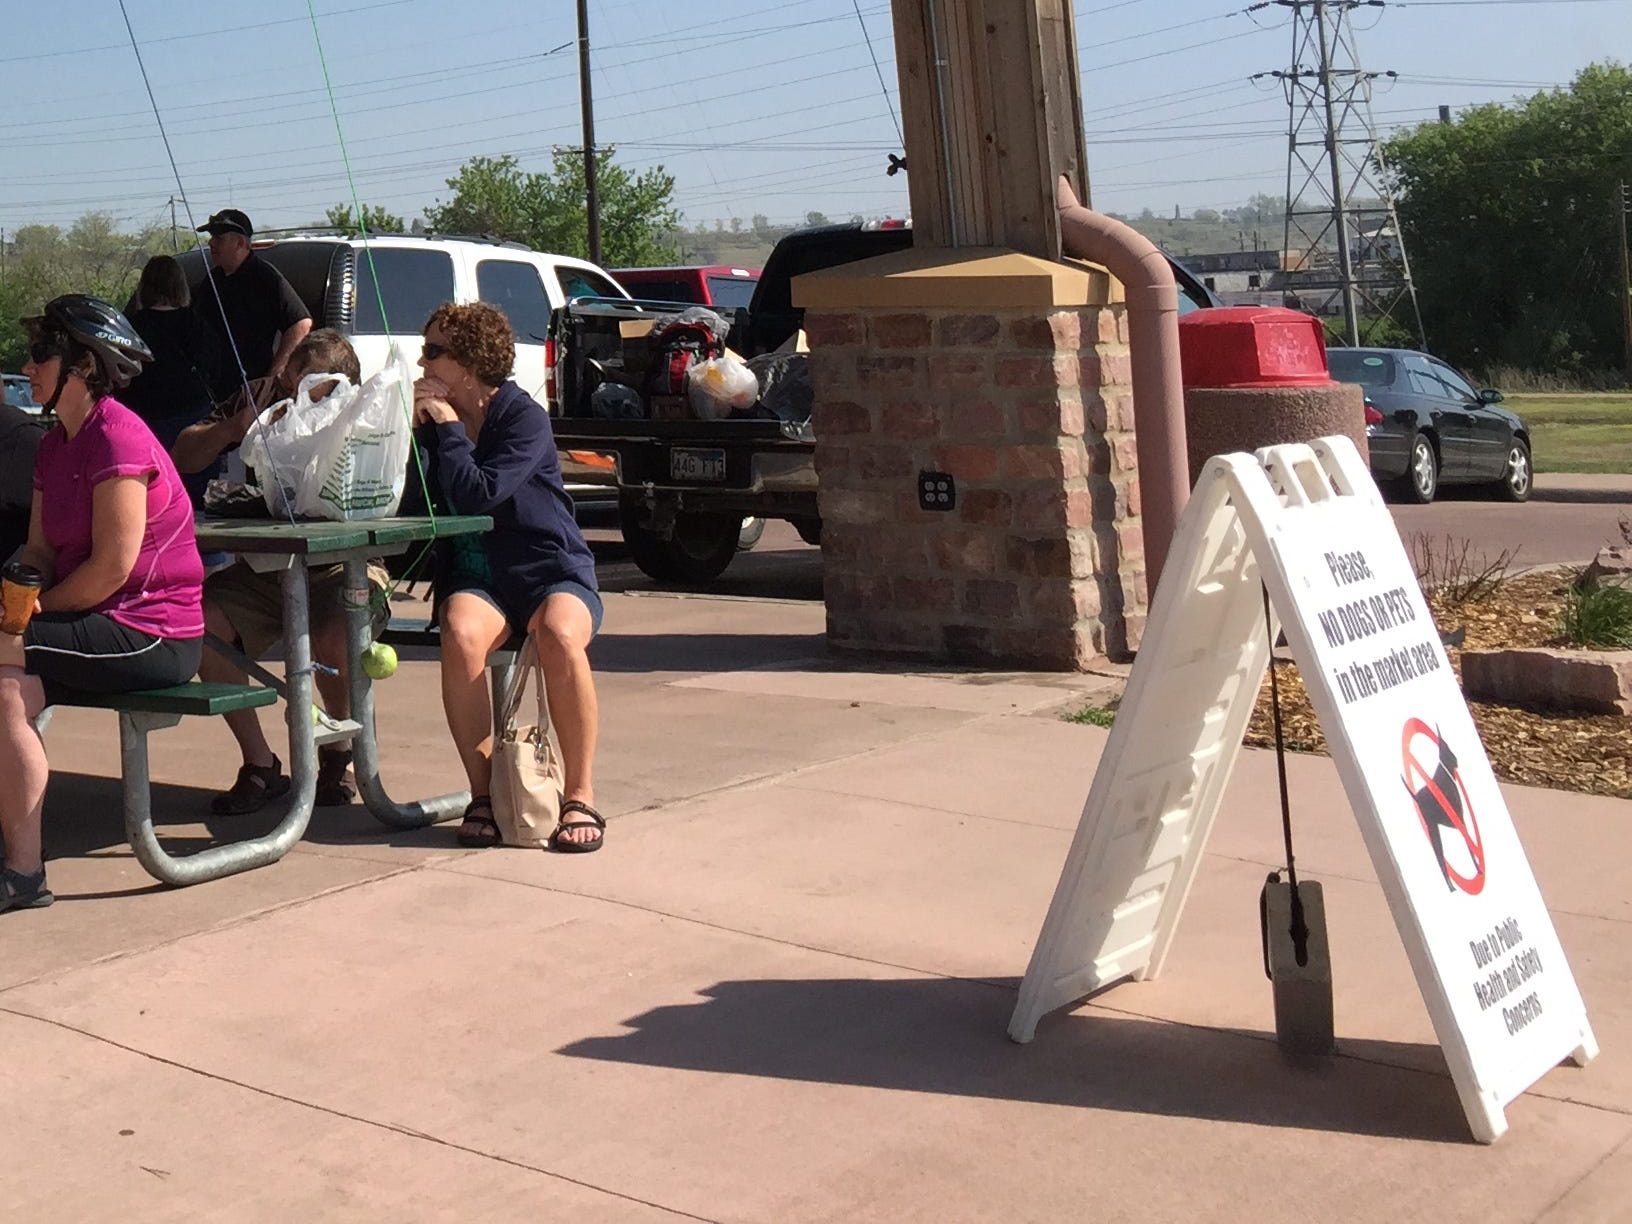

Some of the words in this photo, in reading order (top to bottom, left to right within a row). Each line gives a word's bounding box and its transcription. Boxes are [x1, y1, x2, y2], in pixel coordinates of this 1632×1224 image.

[1324, 550, 1375, 587] Please,
[1318, 608, 1345, 648] NO
[1336, 596, 1377, 643] DOGS
[1369, 592, 1394, 633] OR
[1387, 587, 1416, 628] PETS
[1333, 668, 1357, 704] in
[1349, 661, 1378, 698] the
[1373, 646, 1418, 690] market
[1411, 642, 1440, 676] area
[1469, 940, 1493, 969] Due
[1487, 933, 1502, 959] to
[1495, 917, 1523, 954] Public
[1473, 970, 1508, 1011] Health
[1503, 958, 1522, 992] and
[1515, 947, 1544, 982] Safety
[1503, 991, 1543, 1036] Concerns
